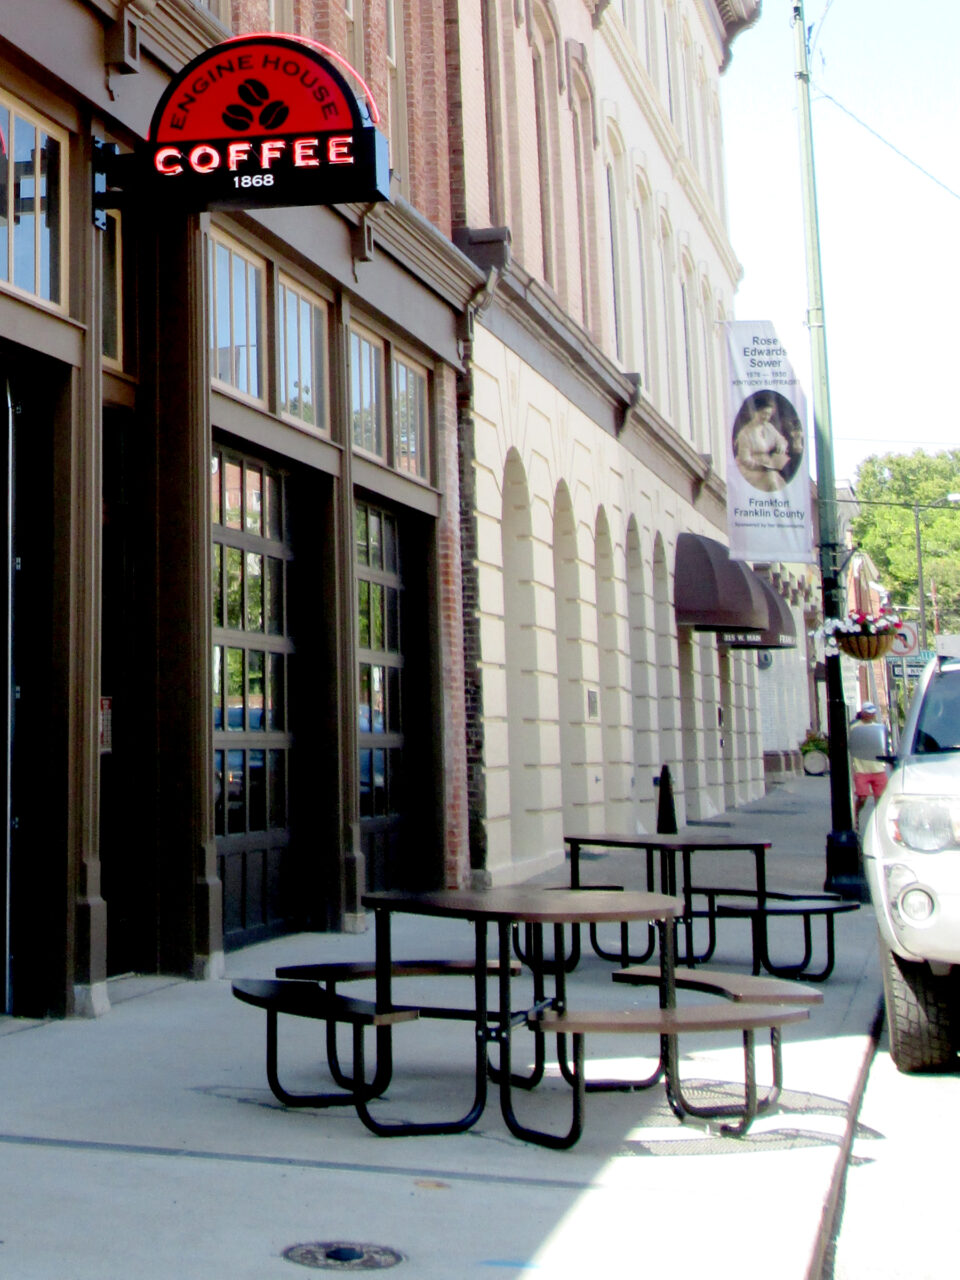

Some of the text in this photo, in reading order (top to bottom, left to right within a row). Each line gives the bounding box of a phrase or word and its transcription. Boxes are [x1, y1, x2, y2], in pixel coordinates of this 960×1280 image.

[170, 54, 339, 130] ENGINE HOUSE
[154, 136, 355, 176] COFFEE
[233, 174, 274, 188] 1868
[752, 336, 779, 346] Rose
[743, 347, 788, 357] Edwards
[750, 358, 782, 368] Sower
[749, 498, 790, 508] Frankfort
[734, 507, 805, 521] Franklin County
